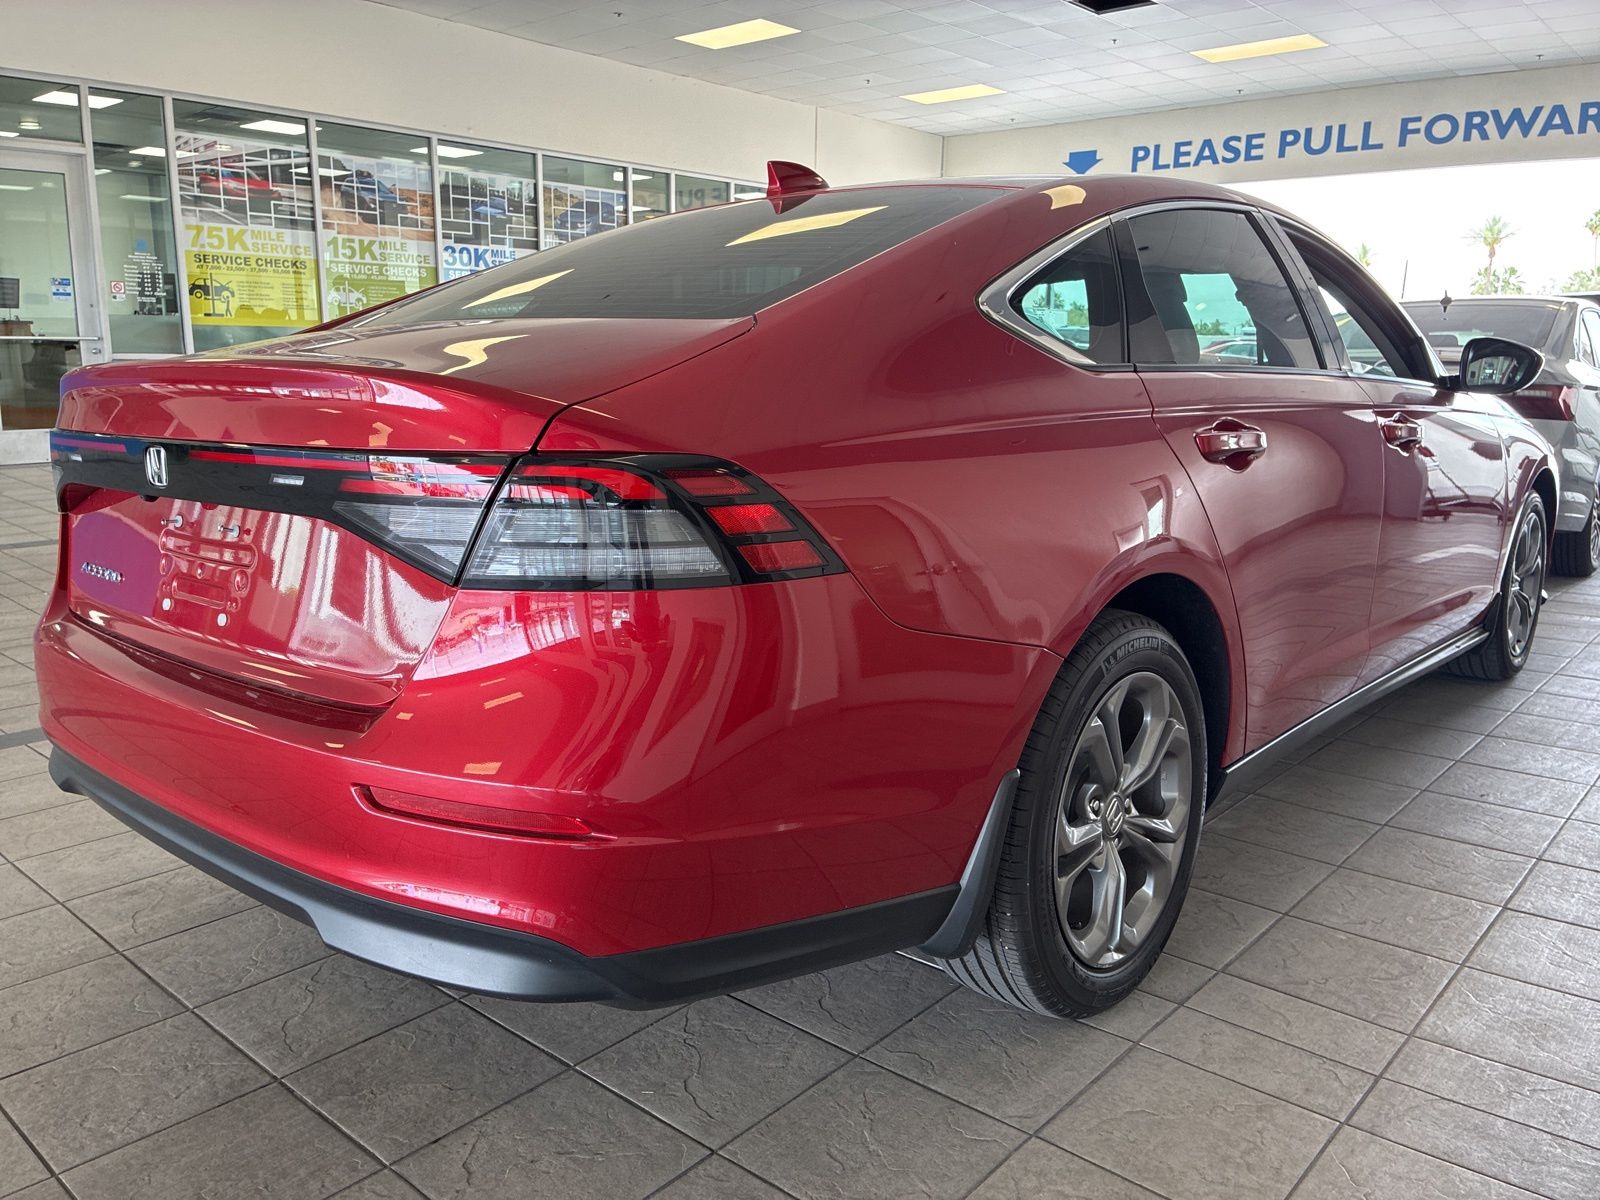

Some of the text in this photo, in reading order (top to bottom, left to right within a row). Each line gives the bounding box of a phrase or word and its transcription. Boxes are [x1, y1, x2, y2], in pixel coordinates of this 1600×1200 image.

[1131, 132, 1266, 173] PLEASE
[1277, 120, 1384, 159] PULL
[251, 230, 285, 242] MILE
[251, 242, 313, 257] SERVICE
[327, 236, 379, 262] 15K
[378, 240, 408, 252] MILE
[193, 253, 308, 270] SERVICE CHECKS
[379, 252, 431, 264] SERVICE
[443, 245, 491, 270] 30K
[490, 249, 516, 261] MILE
[330, 262, 428, 278] SERVICE CHECKS
[81, 561, 123, 583] ACCORD
[1116, 637, 1159, 661] MICHELIN
